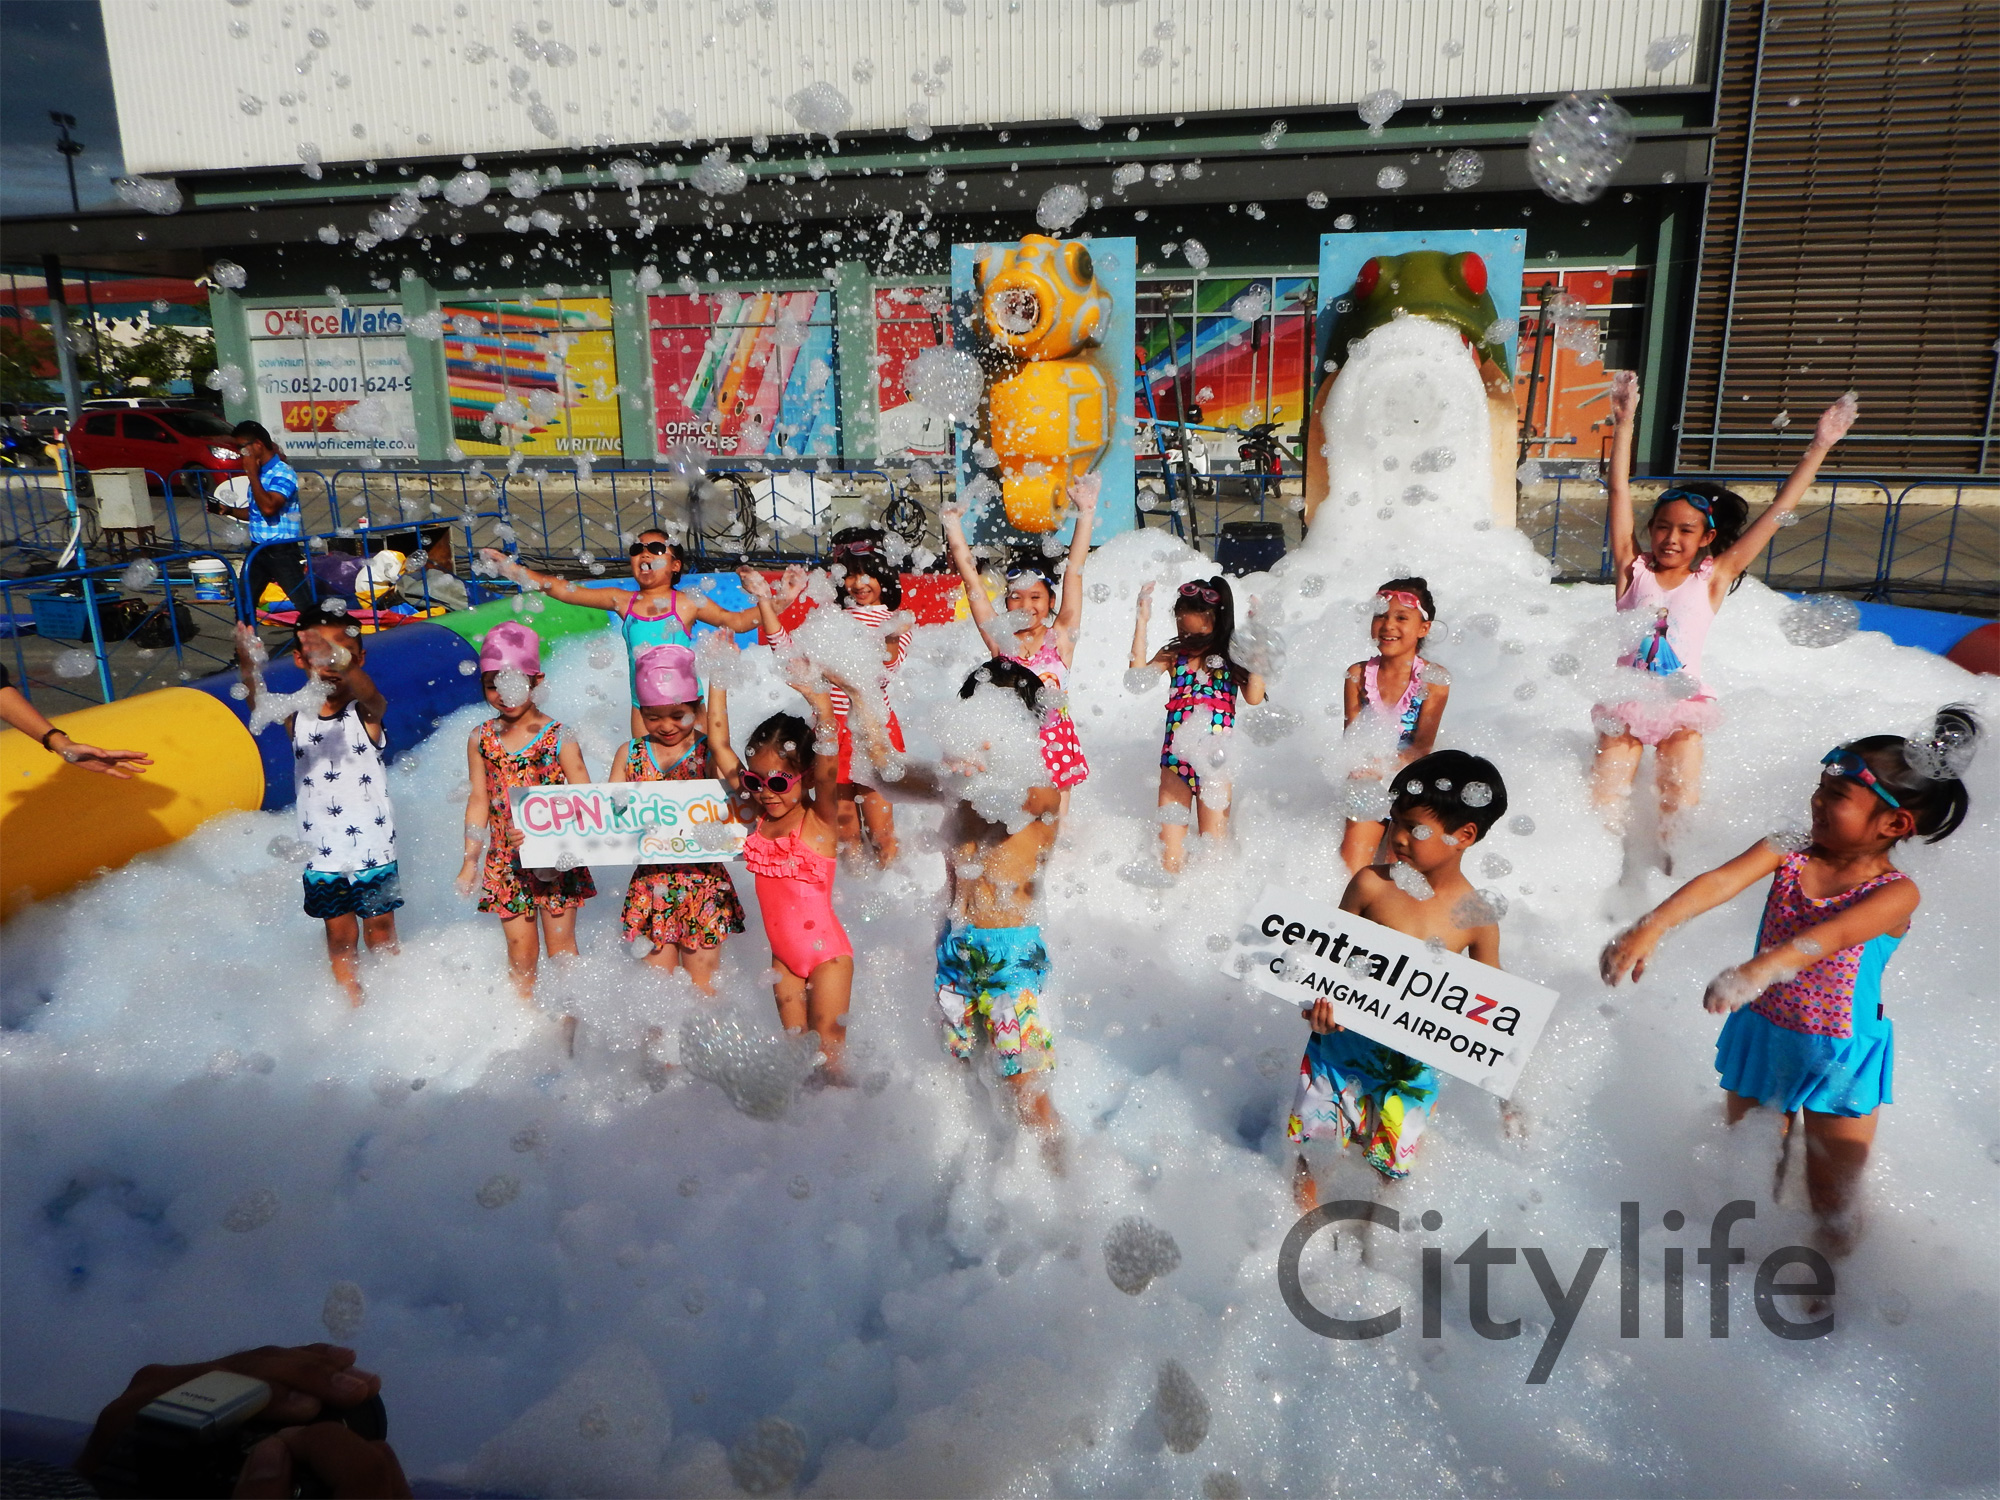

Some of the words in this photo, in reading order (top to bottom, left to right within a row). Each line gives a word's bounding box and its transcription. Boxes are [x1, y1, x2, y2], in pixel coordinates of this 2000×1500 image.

[285, 406, 328, 427] 499
[665, 422, 719, 435] OFFICE
[285, 437, 415, 450] wwwofficemate.co.
[665, 435, 738, 449] SUPPLES
[523, 795, 603, 831] CPN
[610, 794, 678, 829] kids
[688, 796, 755, 825] club
[1269, 957, 1391, 1020] CANGMAI
[1393, 1011, 1505, 1067] AIRPORT
